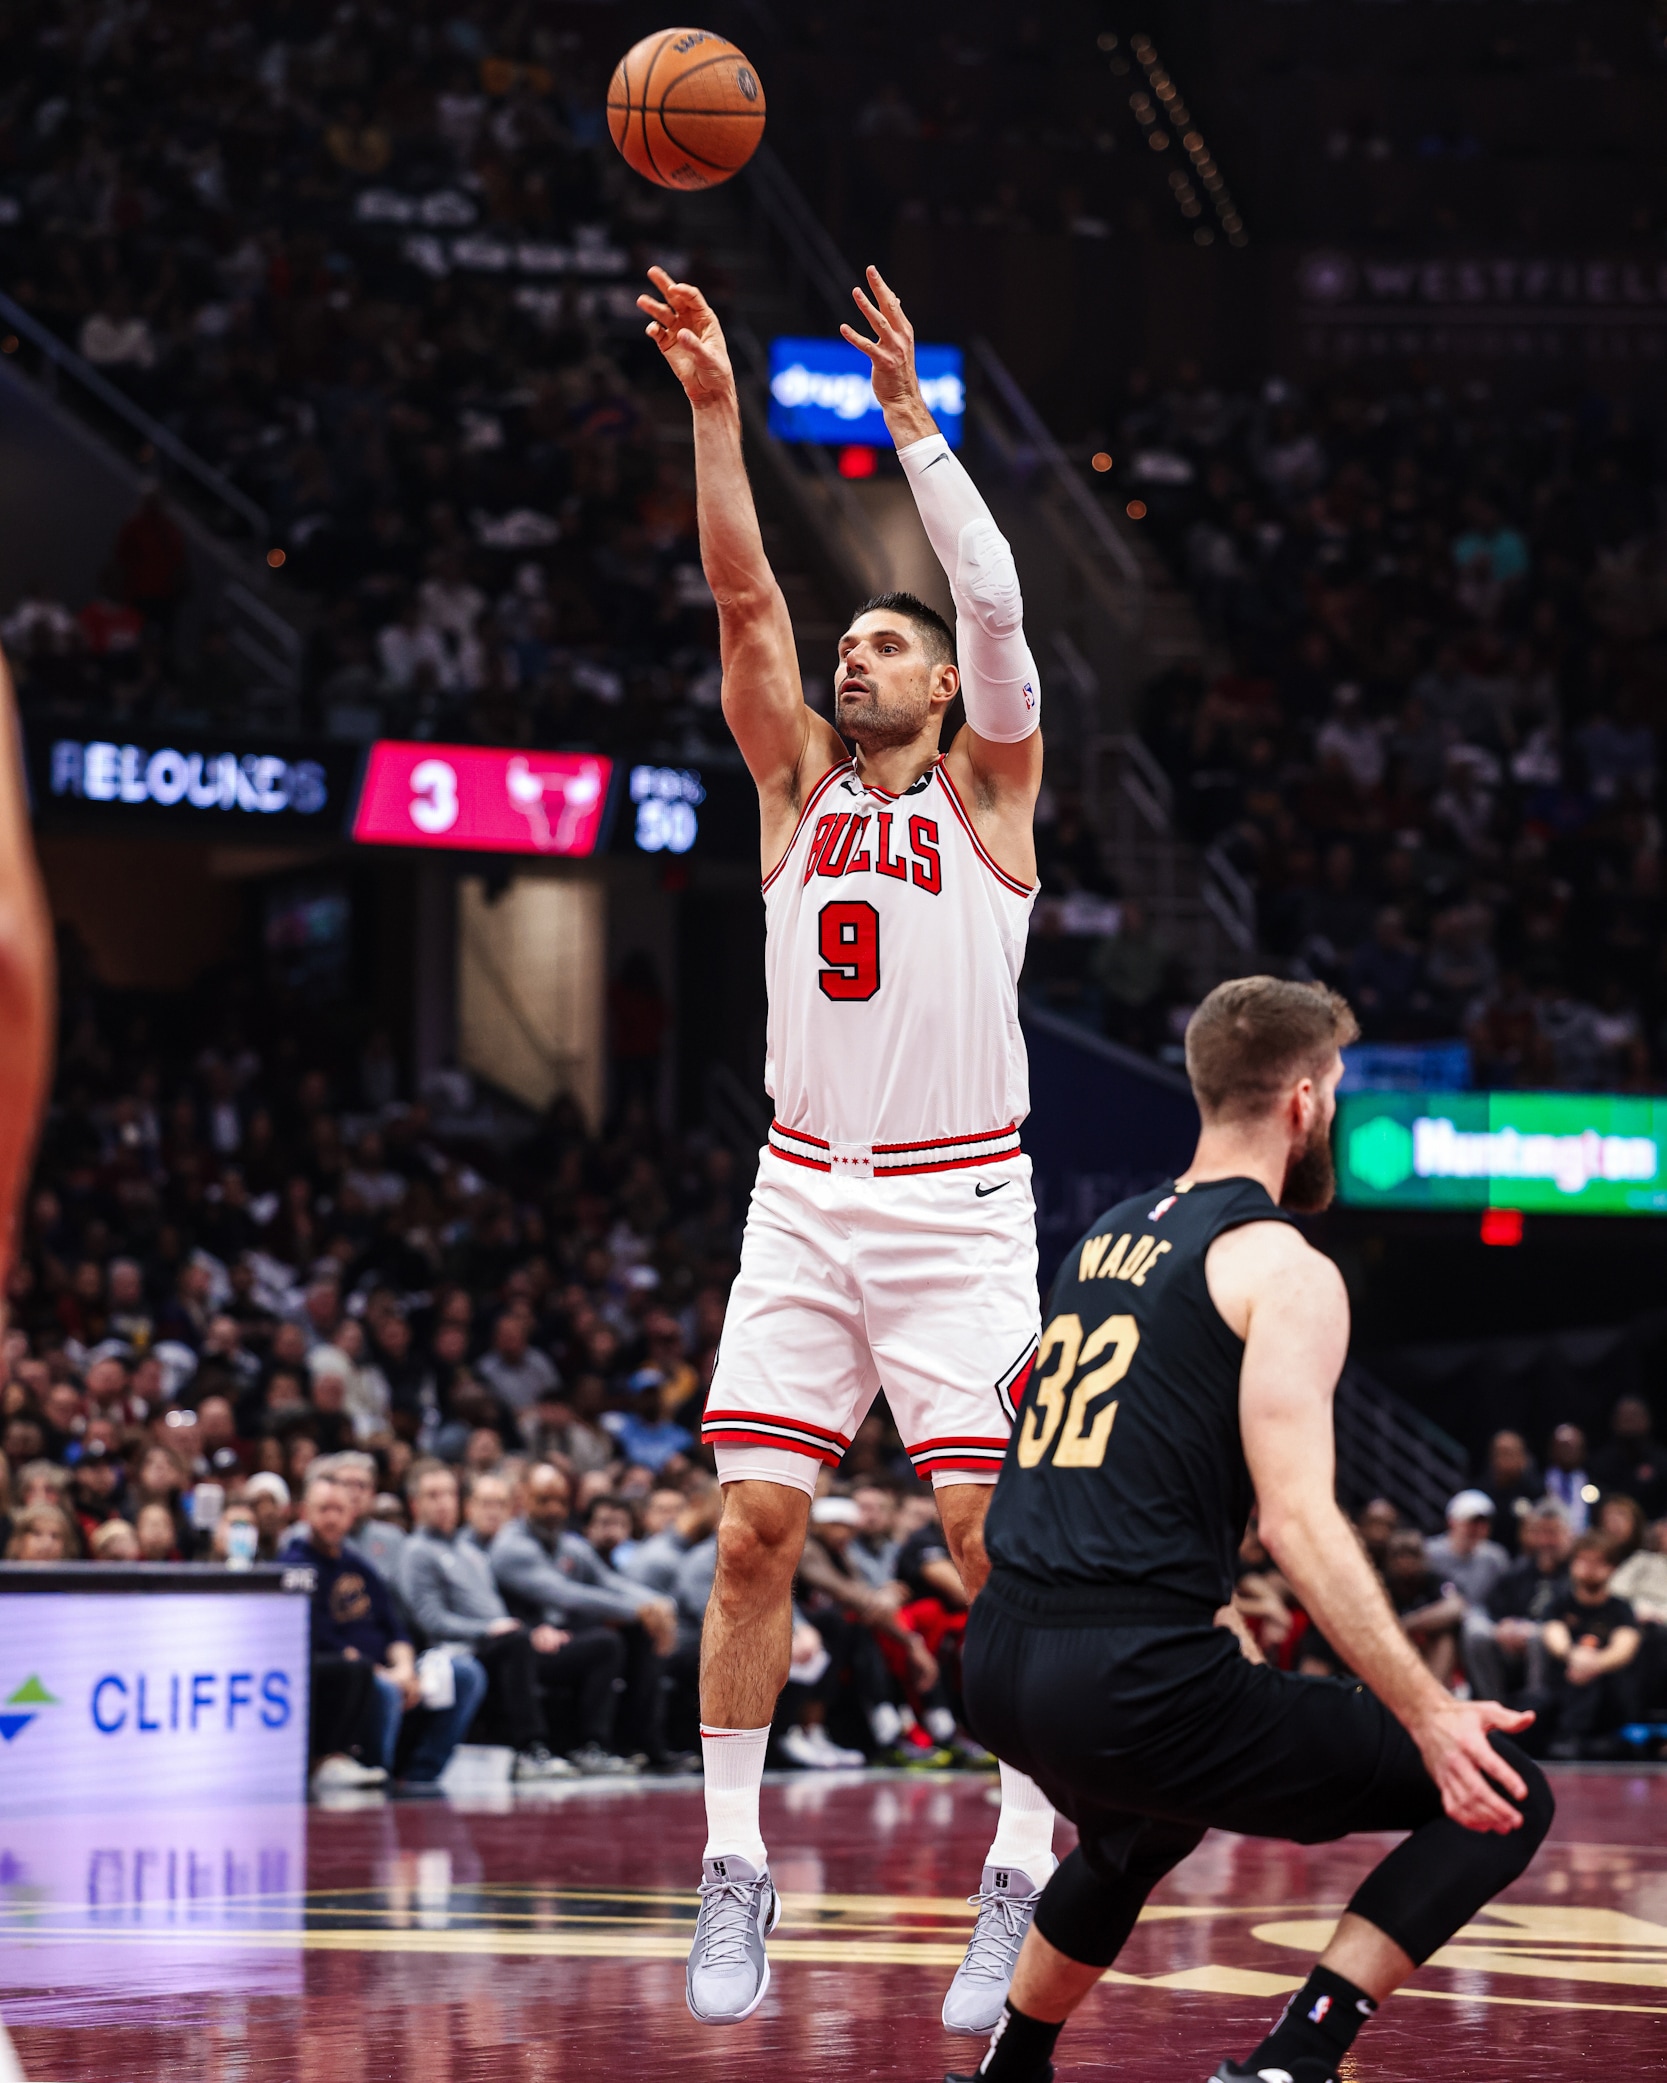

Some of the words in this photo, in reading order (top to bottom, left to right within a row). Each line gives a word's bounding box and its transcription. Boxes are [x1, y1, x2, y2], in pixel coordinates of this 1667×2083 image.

[409, 758, 459, 835] 3
[803, 812, 942, 896] BULLS
[818, 900, 881, 1002] 9
[1078, 1233, 1173, 1287] WADE
[1017, 1313, 1140, 1469] 32
[91, 1670, 291, 1734] CLIFFS
